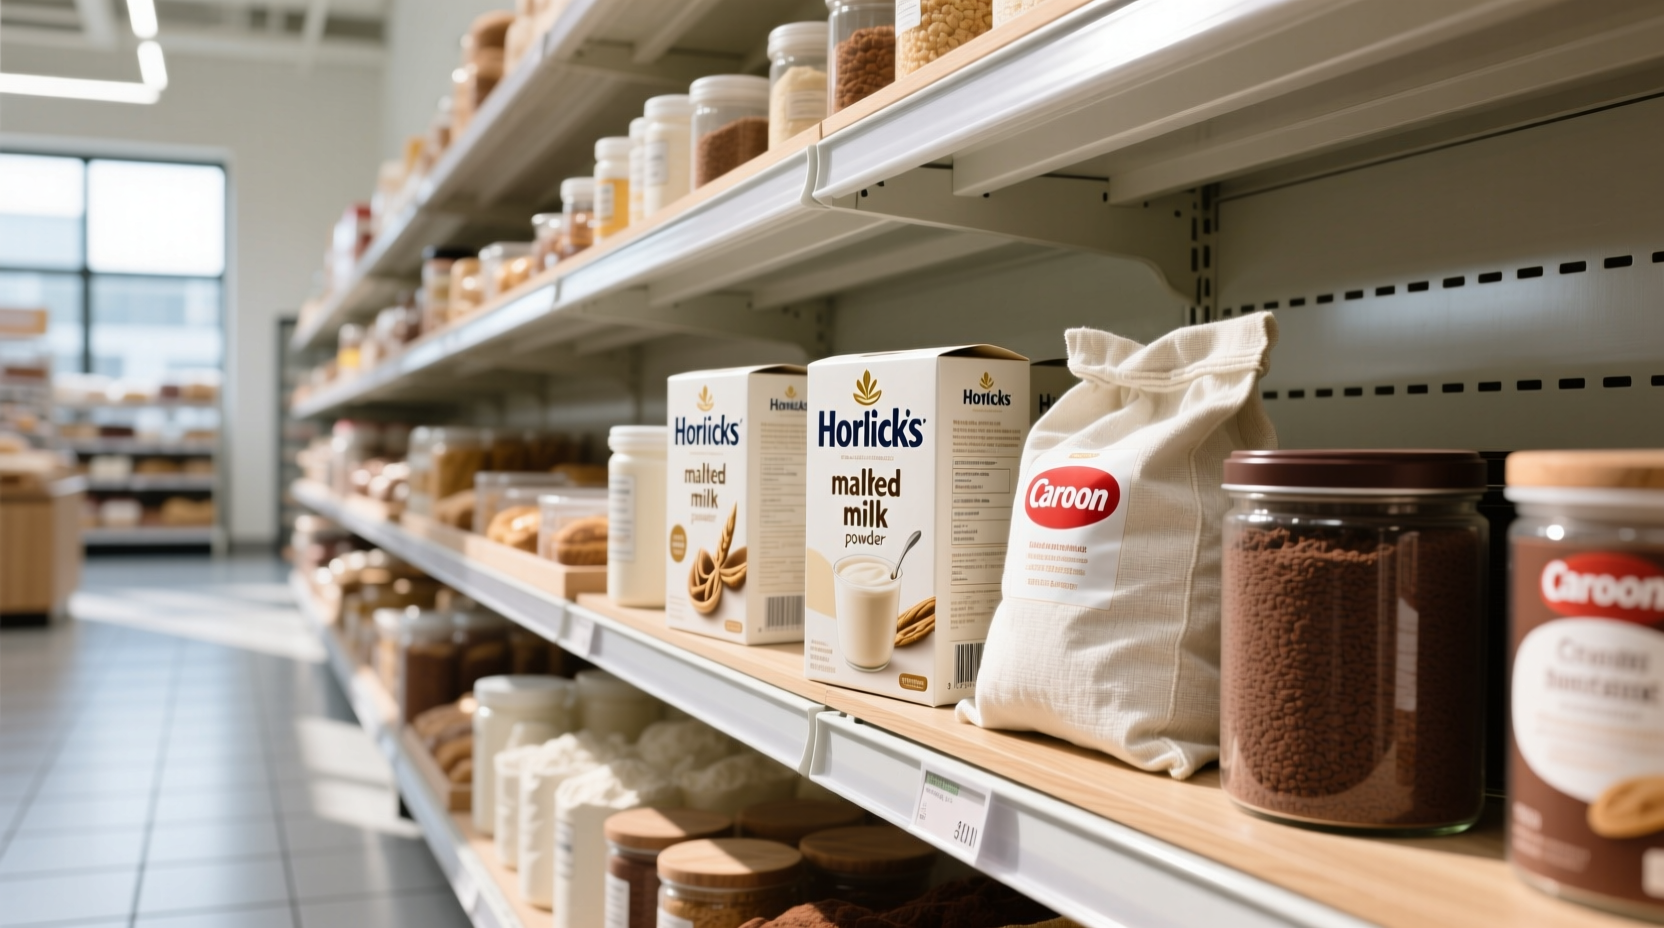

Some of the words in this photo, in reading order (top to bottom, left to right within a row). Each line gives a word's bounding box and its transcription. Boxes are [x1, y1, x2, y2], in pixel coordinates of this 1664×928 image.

[684, 463, 726, 485] malted
[831, 468, 901, 497] malted
[691, 488, 718, 509] milk
[1029, 478, 1109, 512] Caroon
[843, 499, 889, 528] milk
[845, 530, 886, 548] powder
[1541, 559, 1664, 612] Caroon
